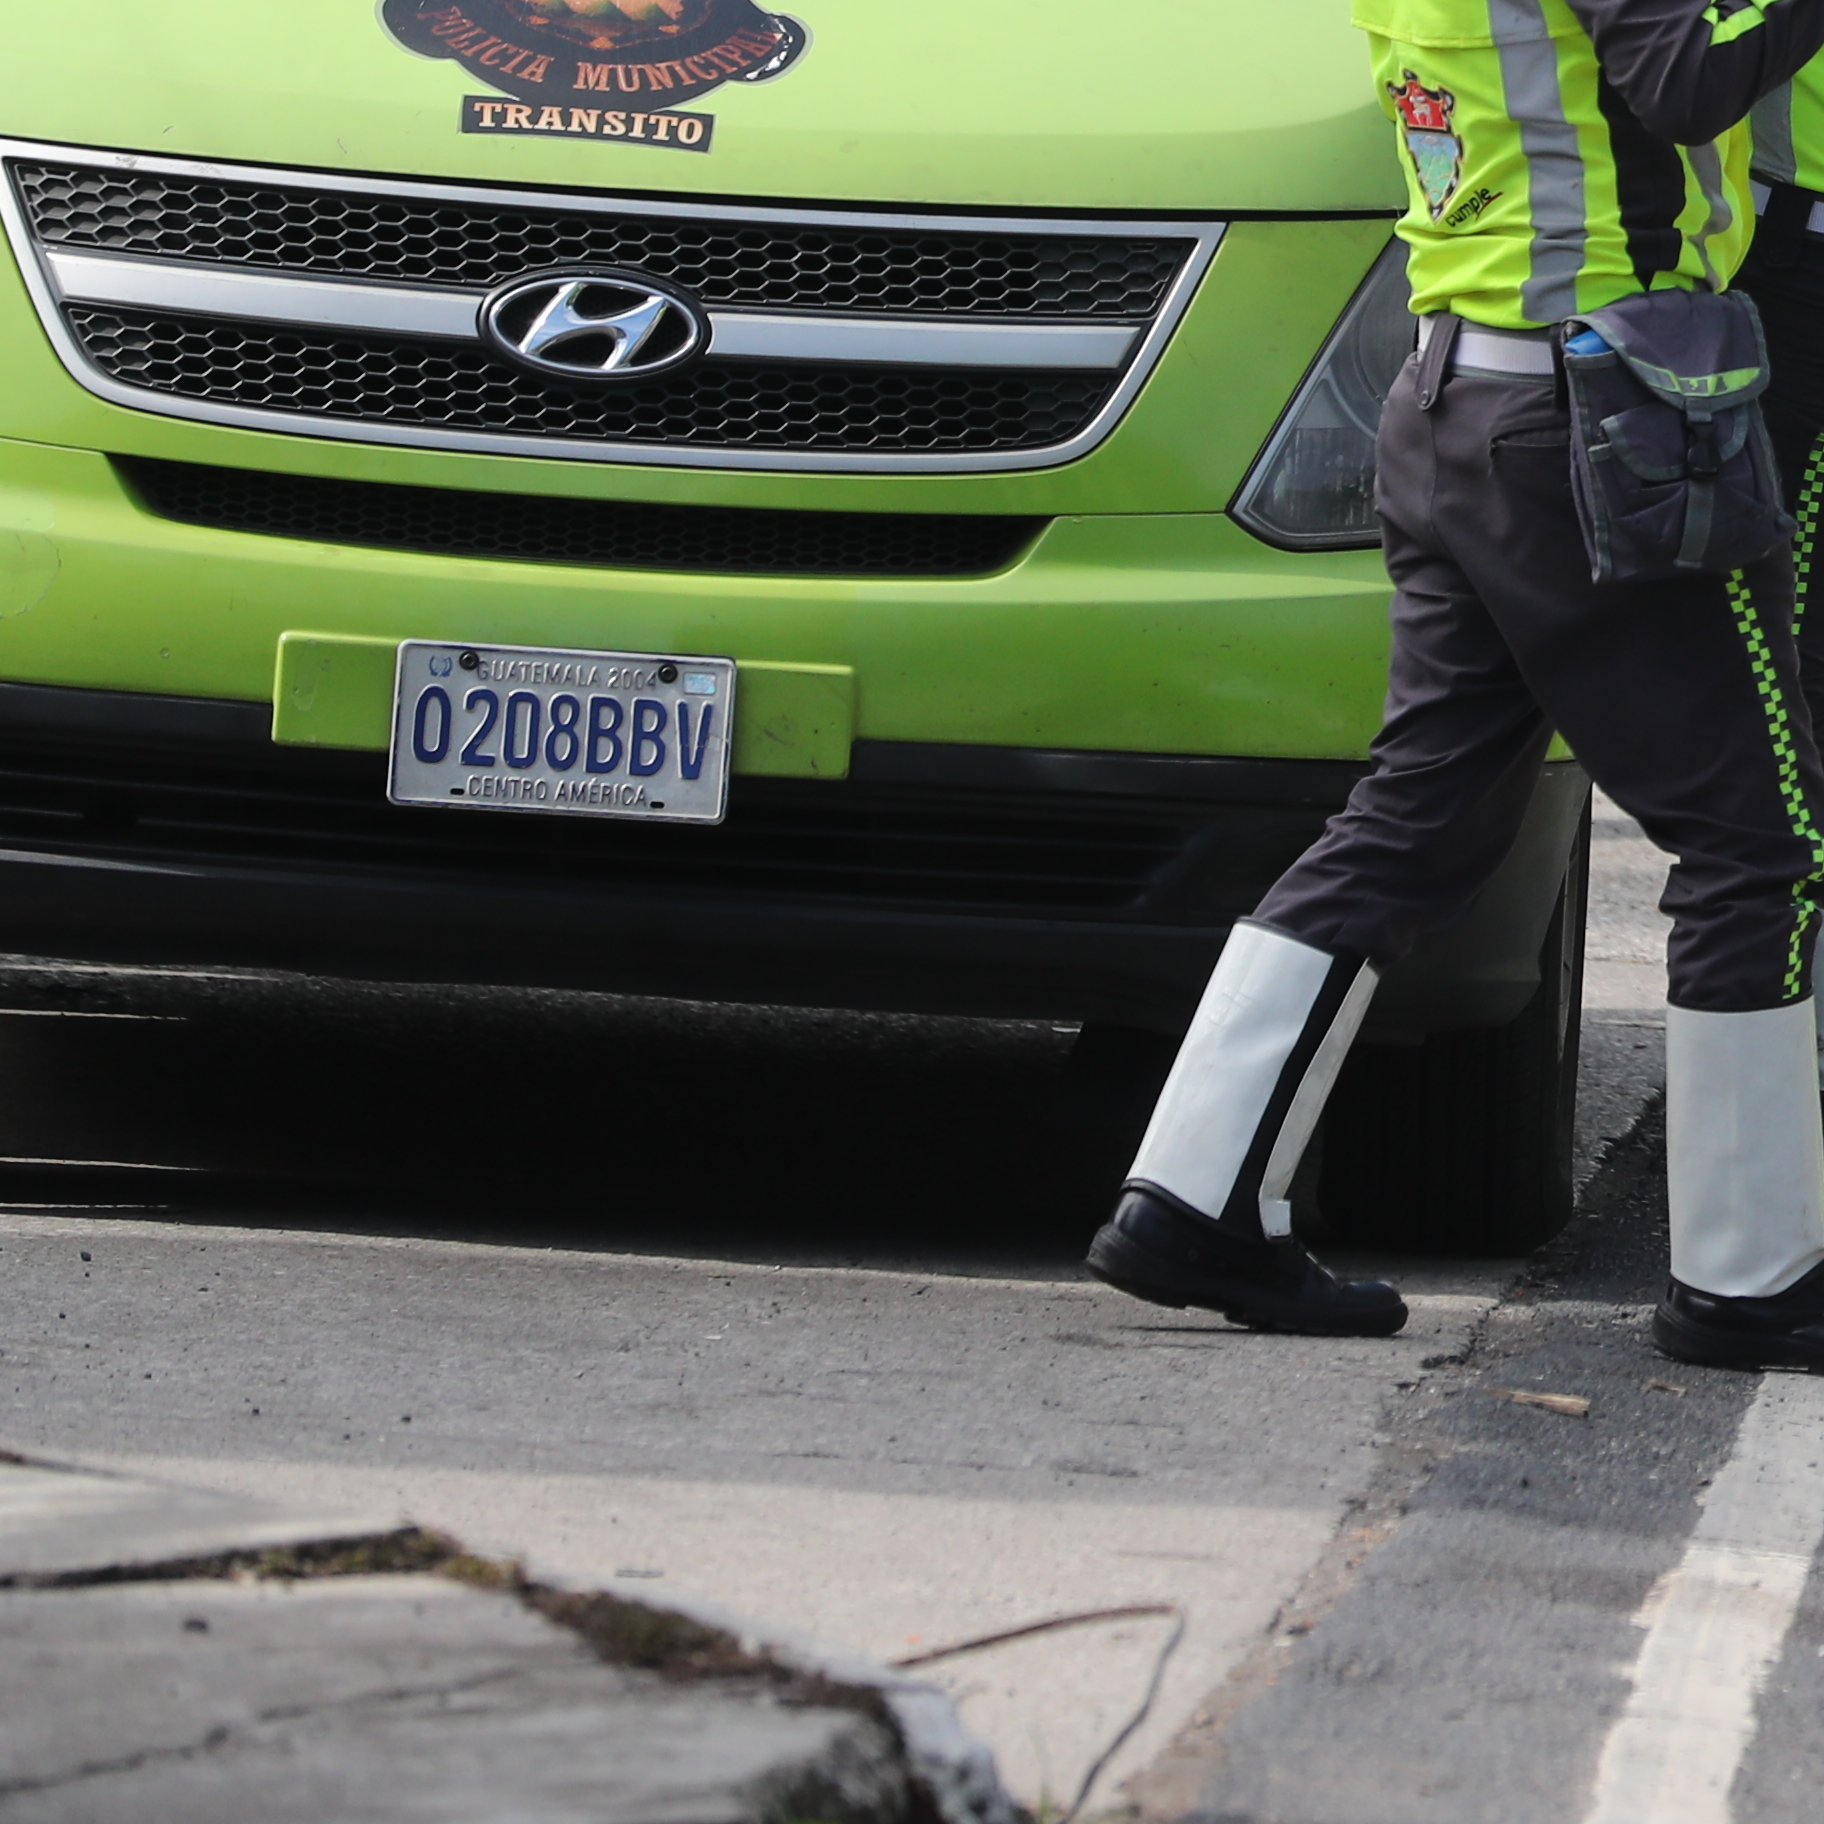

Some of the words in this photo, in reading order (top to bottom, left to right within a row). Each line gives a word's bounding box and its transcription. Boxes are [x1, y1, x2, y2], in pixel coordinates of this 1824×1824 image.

[416, 5, 555, 84] POLICIA
[572, 28, 783, 93] MUNICIPAL
[473, 100, 704, 145] TRANSITO
[1445, 187, 1492, 227] cumple
[475, 658, 601, 687] GUATEMALA
[606, 666, 657, 692] 2004
[465, 775, 549, 801] CENTRO
[553, 776, 648, 808] AMÉRICA
